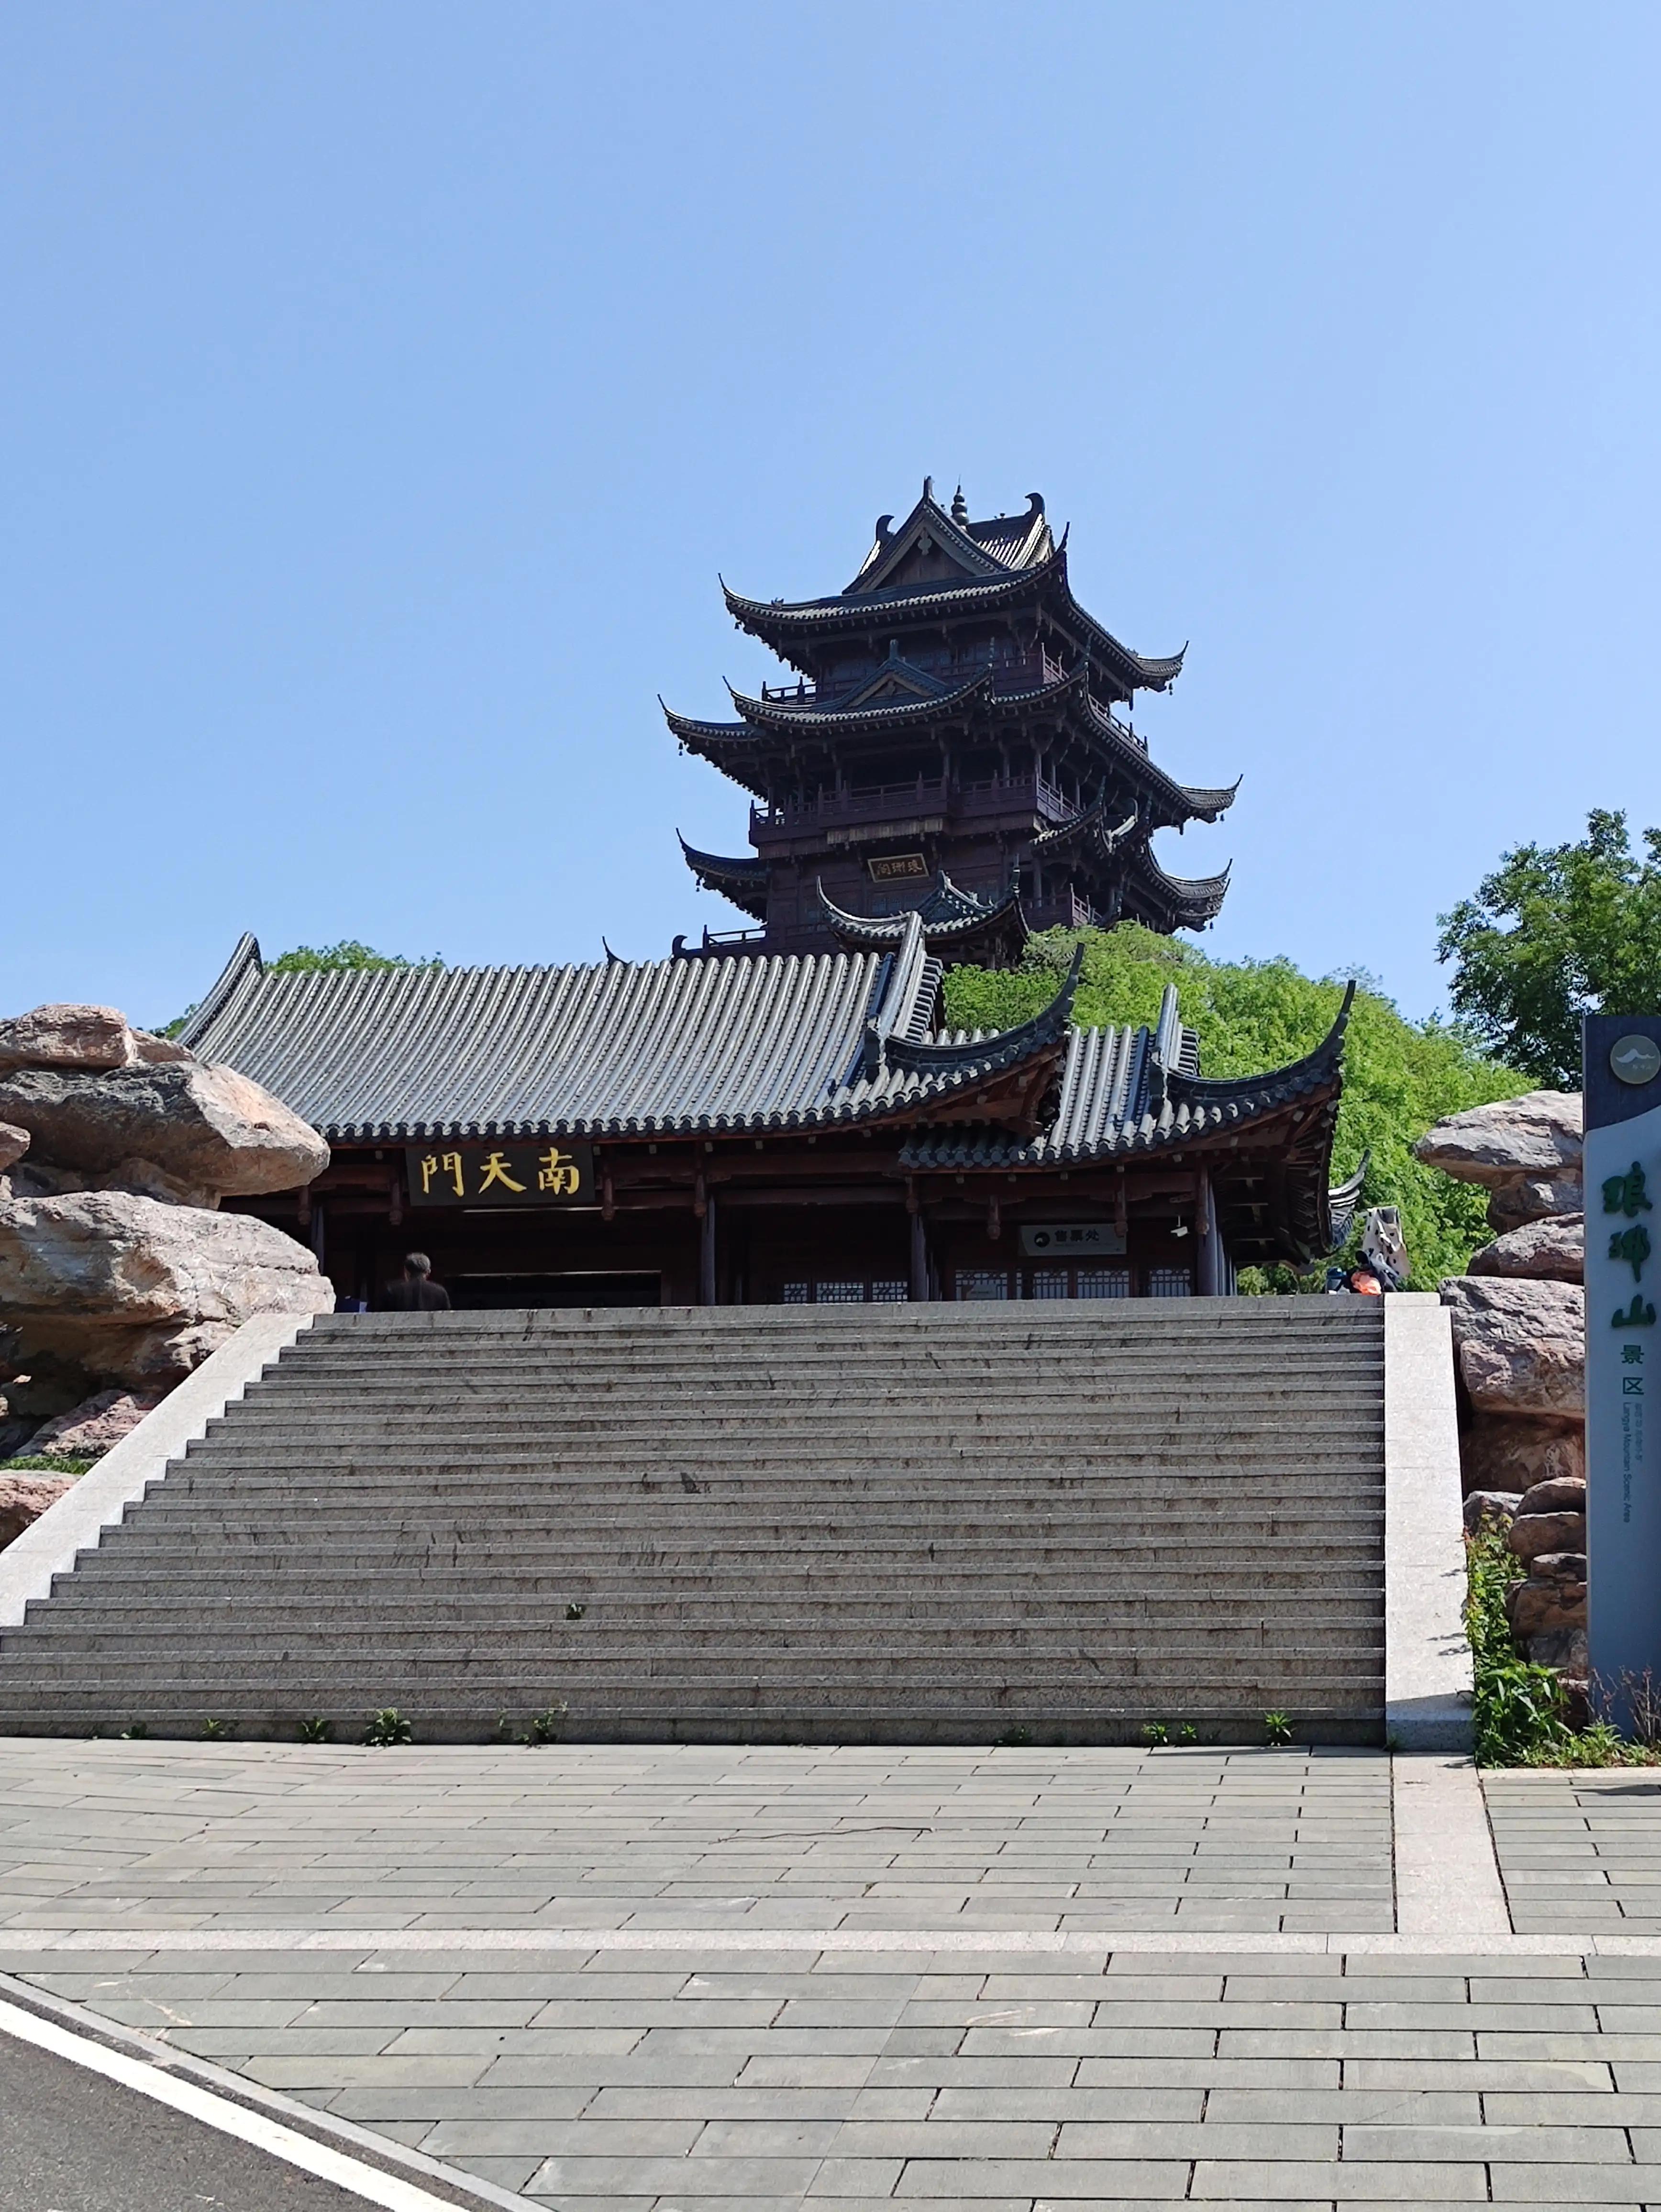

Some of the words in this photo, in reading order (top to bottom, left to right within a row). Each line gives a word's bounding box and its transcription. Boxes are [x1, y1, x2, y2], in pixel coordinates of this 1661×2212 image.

[421, 1147, 580, 1197] 南天門
[1054, 1229, 1099, 1242] 售票处
[1621, 1402, 1631, 1431] Langya
[1622, 1434, 1631, 1472] Mountain
[1623, 1474, 1632, 1501] Scenic
[1623, 1503, 1632, 1523] Area
